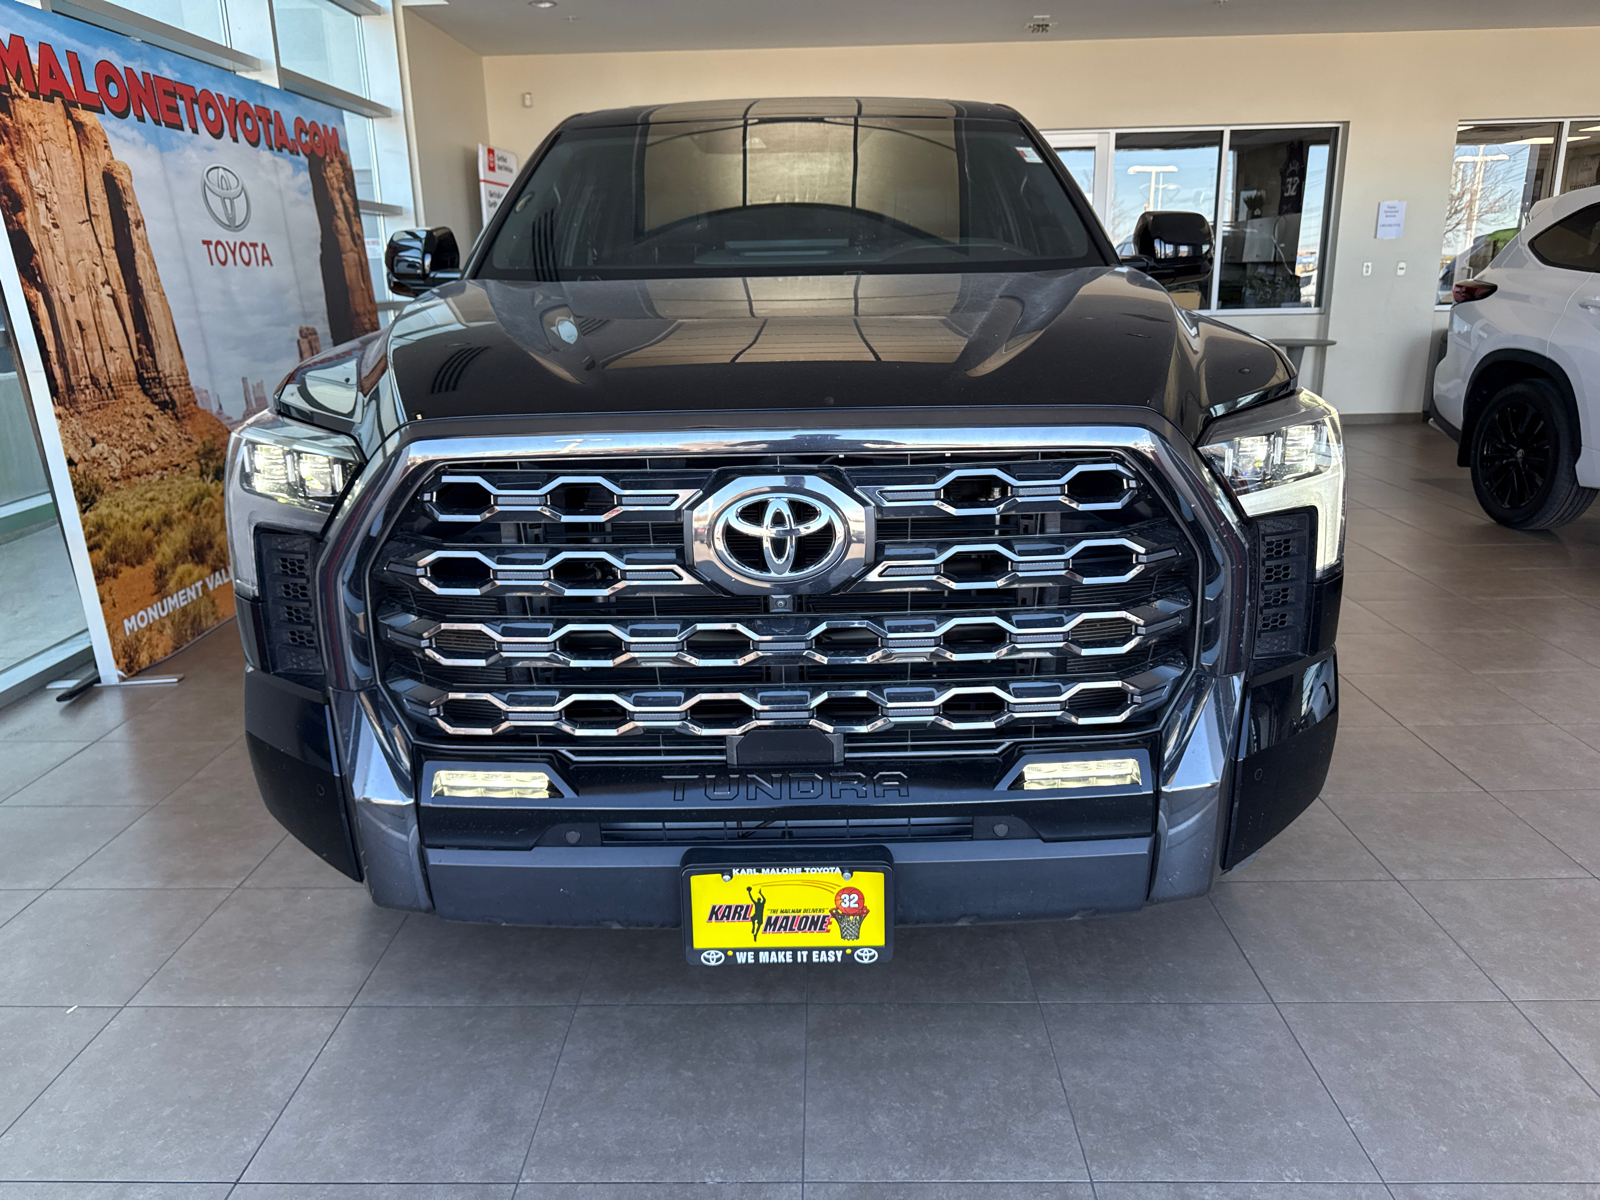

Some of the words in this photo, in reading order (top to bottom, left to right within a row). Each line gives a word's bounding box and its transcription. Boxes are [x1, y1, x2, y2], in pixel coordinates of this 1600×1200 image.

[0, 33, 344, 160] MALONETOYOTA.COM
[1284, 176, 1300, 197] 32
[202, 240, 273, 267] TOYOTA
[123, 580, 204, 637] MONUMENT
[661, 771, 910, 801] TUNDRA
[732, 868, 759, 876] KARL
[761, 867, 802, 875] MALONE
[804, 866, 842, 874] TOYOTA
[840, 893, 859, 909] 32
[706, 904, 753, 922] KARL
[762, 914, 832, 934] MALONE
[736, 951, 755, 964] WE
[758, 951, 793, 964] MAKE
[797, 950, 808, 962] IT
[813, 950, 843, 962] EASY
